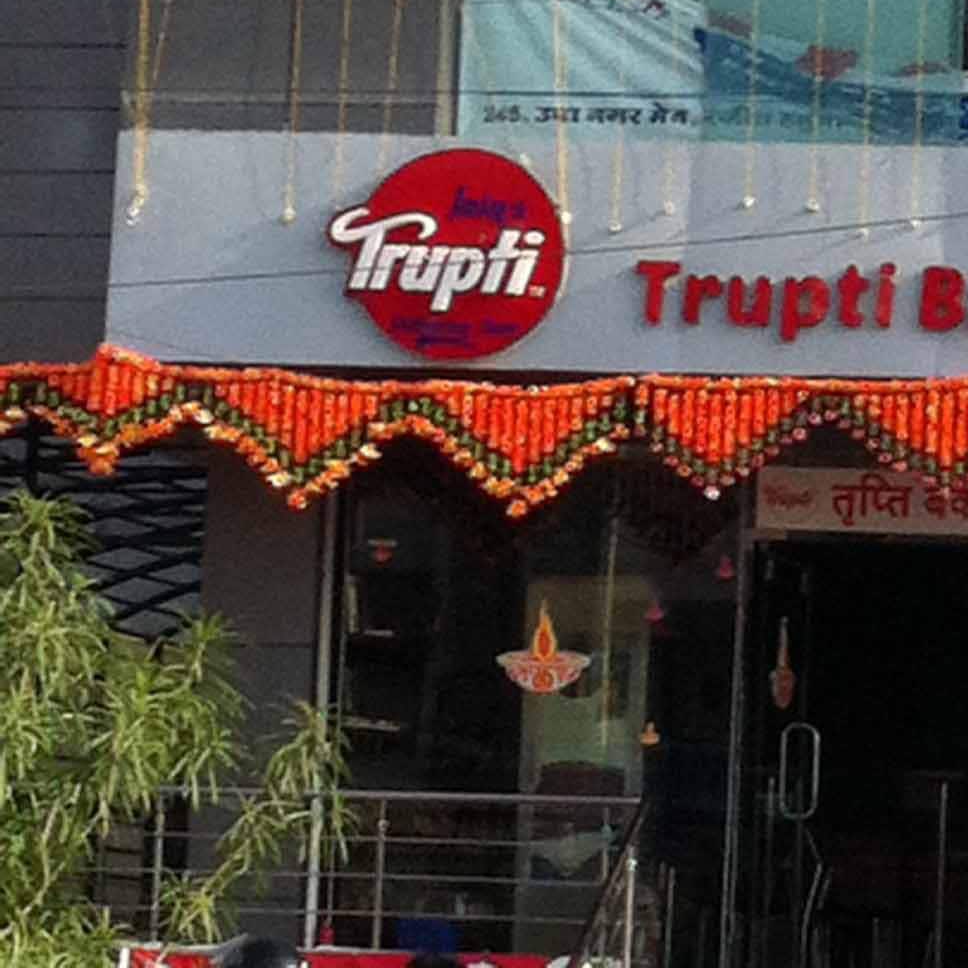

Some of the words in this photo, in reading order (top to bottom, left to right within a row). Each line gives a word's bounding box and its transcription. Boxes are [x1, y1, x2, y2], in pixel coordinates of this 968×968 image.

[330, 207, 546, 312] Trupti
[634, 260, 896, 342] Trupti
[831, 473, 913, 526] तृप्ति
